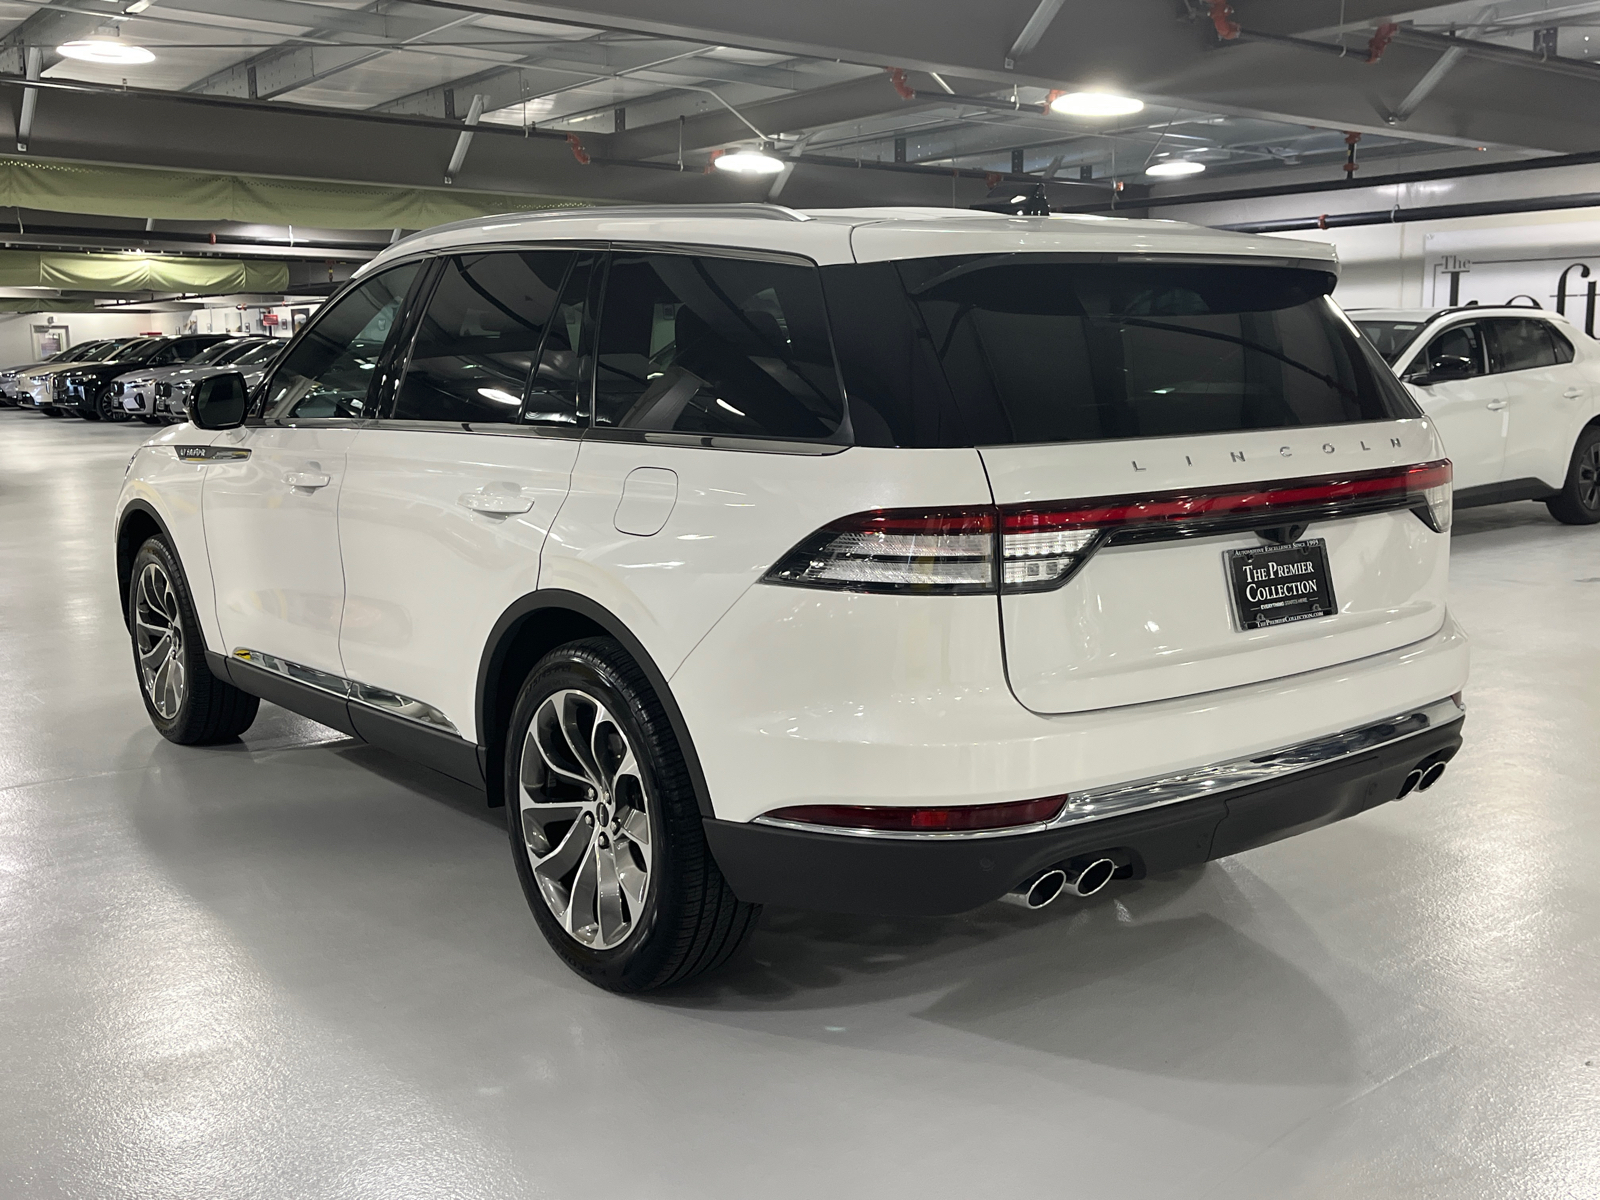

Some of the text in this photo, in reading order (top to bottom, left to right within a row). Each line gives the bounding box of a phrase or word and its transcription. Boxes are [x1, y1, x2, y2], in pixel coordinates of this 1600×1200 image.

[1441, 255, 1471, 270] The
[1131, 437, 1402, 472] LINCOLN
[1242, 561, 1315, 583] THE PREMIER
[1245, 579, 1318, 602] COLLECTION
